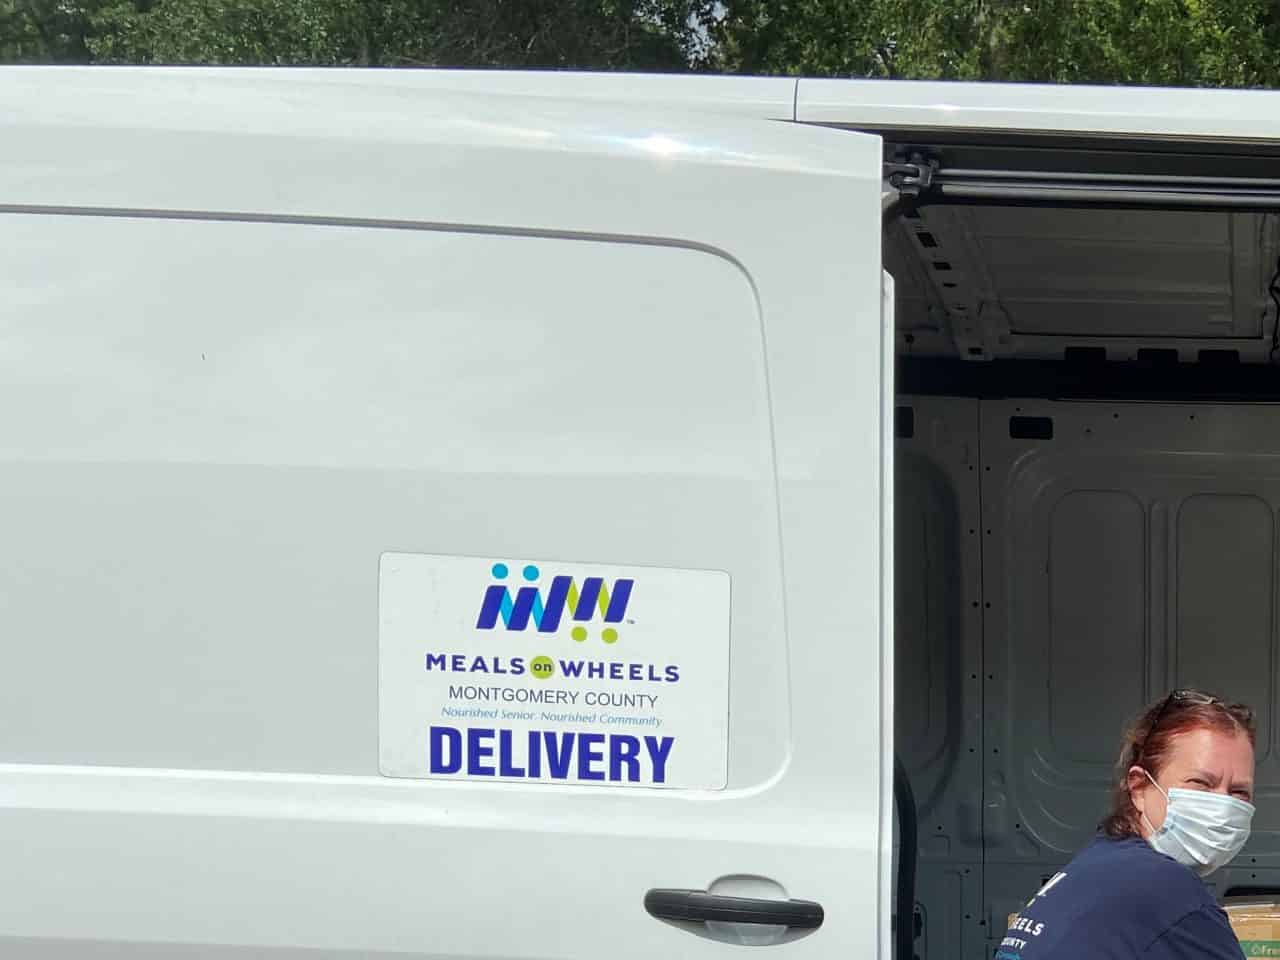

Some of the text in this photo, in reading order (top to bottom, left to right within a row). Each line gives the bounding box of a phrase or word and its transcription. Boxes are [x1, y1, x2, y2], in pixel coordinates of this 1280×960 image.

[426, 653, 680, 683] MEALS on WHEELS
[448, 685, 659, 709] MONTGOMERY COUNTY
[441, 706, 498, 720] Nourished
[540, 711, 597, 723] Nourished
[599, 712, 663, 728] Community
[429, 725, 675, 783] DELIVERY
